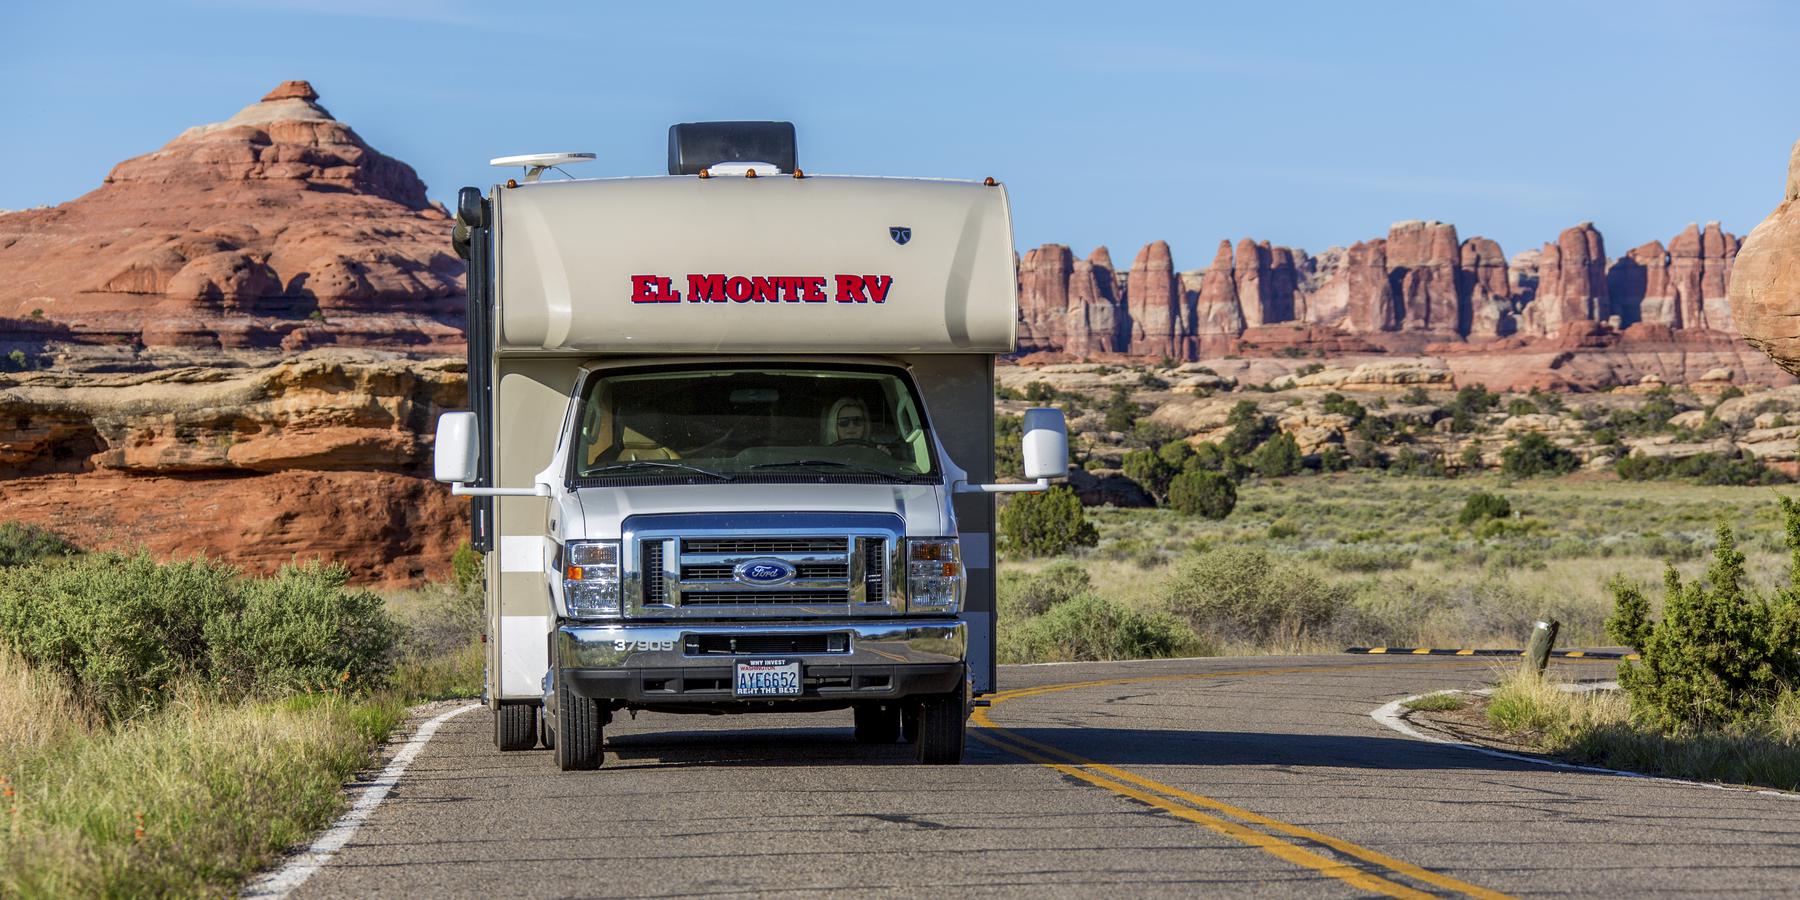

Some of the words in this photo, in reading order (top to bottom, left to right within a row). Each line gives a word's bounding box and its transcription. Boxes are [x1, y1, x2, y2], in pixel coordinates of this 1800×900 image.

[630, 274, 681, 304] EL
[686, 273, 827, 304] MONTE
[834, 274, 893, 304] RV
[752, 566, 778, 578] Ford
[614, 639, 673, 651] 37909
[740, 672, 796, 688] AYE6652
